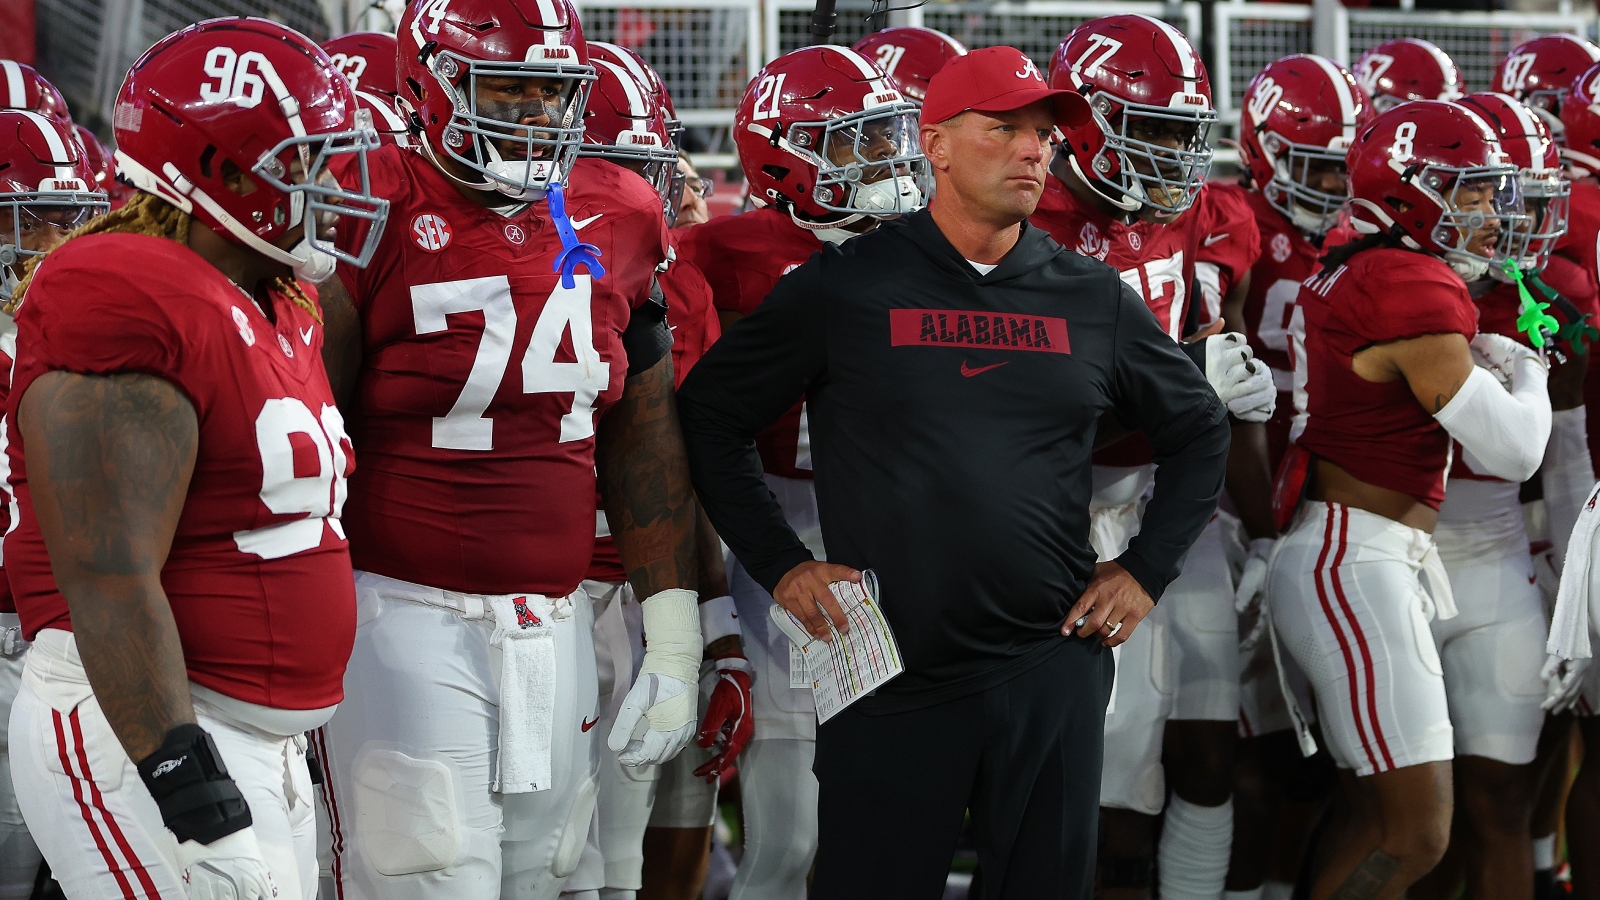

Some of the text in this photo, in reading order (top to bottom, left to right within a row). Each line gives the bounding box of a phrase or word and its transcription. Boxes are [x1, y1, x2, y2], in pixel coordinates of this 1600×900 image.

[544, 48, 570, 59] BAMA
[1071, 33, 1122, 78] 77
[200, 46, 264, 108] 96
[1502, 53, 1537, 92] 87
[753, 73, 787, 121] 21
[876, 93, 898, 103] BAMA
[1184, 95, 1204, 106] BAMA
[1248, 77, 1283, 121] 90
[632, 135, 656, 145] BAMA
[1393, 122, 1418, 162] 8
[53, 181, 80, 190] BAMA
[414, 214, 450, 250] SEC
[1080, 222, 1101, 254] SEC
[920, 313, 1051, 348] ALABAMA
[410, 274, 610, 450] 74
